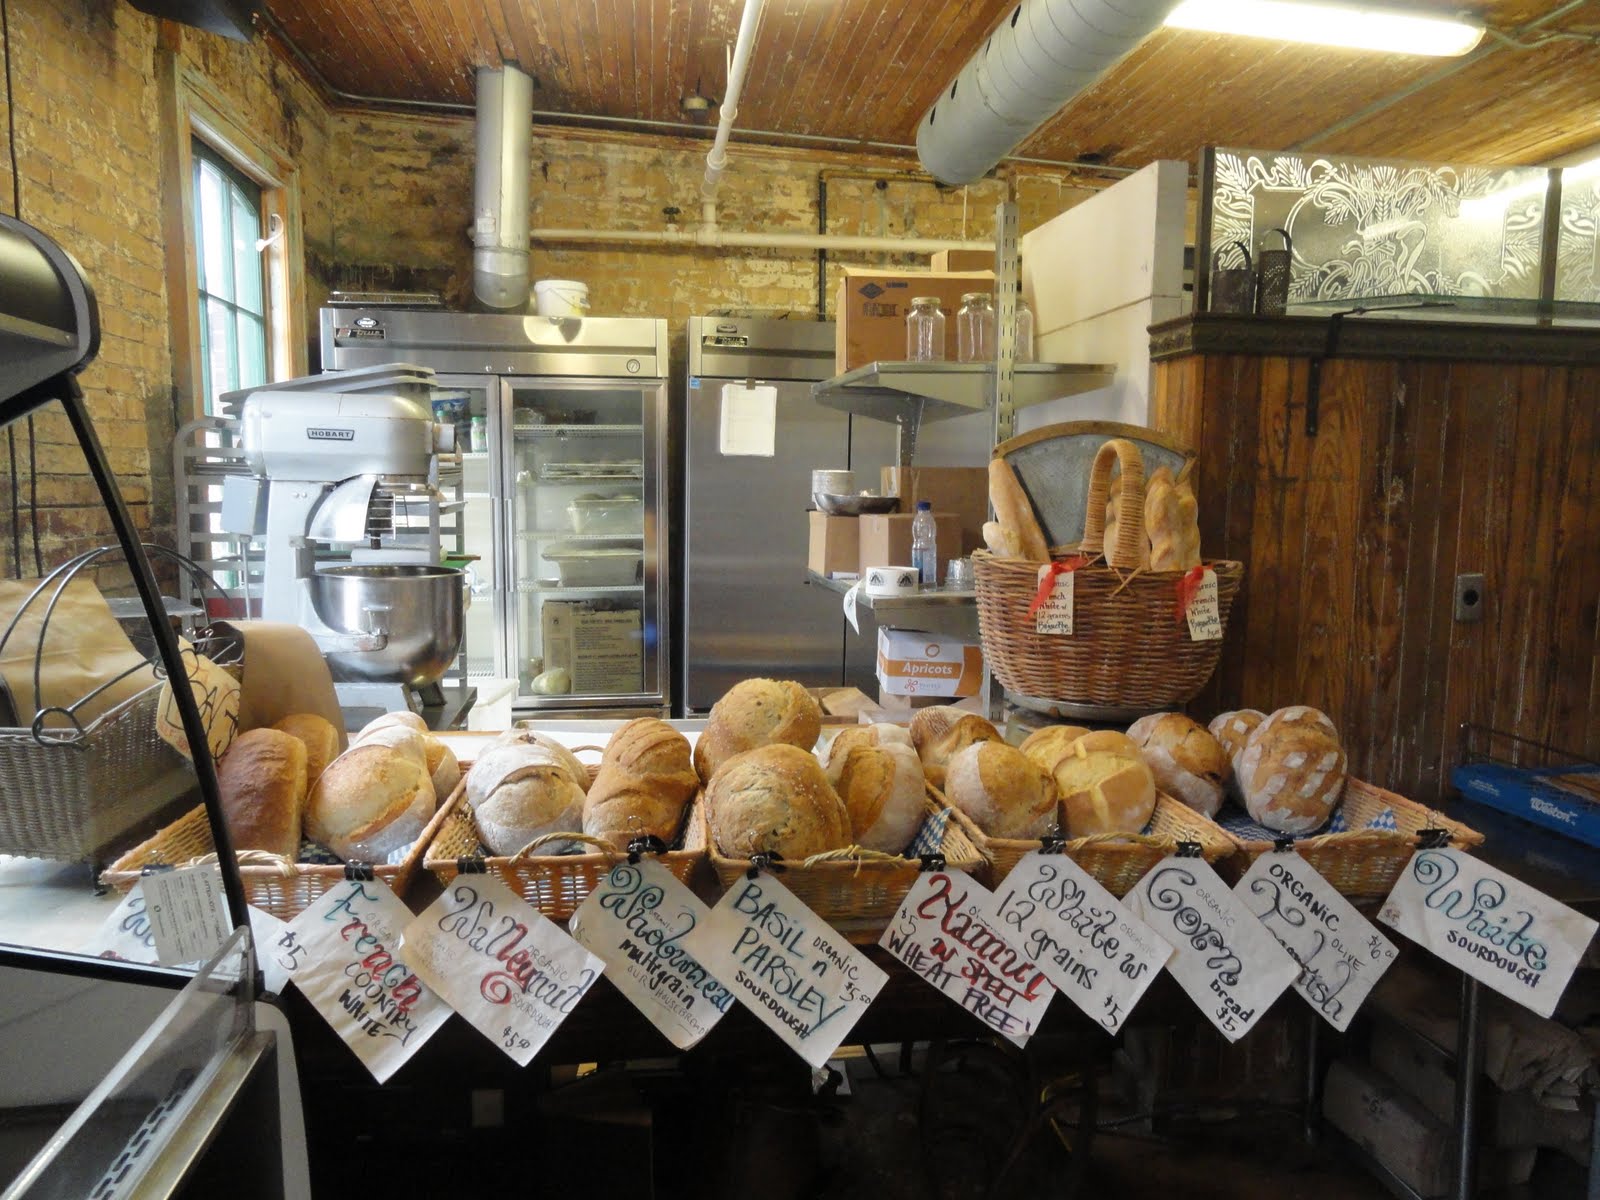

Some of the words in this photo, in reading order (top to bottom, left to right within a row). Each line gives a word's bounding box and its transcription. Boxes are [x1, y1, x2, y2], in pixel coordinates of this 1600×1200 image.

[311, 430, 351, 438] HOBART
[902, 661, 953, 676] Apricots
[734, 883, 804, 958] BASIL
[900, 907, 918, 936] $5
[1028, 864, 1120, 959] White
[1147, 868, 1242, 986] Corn
[1196, 888, 1235, 927] ORGANIC
[1269, 864, 1340, 932] ORGANIC
[1413, 852, 1548, 971] White
[278, 930, 307, 971] $5
[324, 883, 423, 1013] French
[813, 936, 859, 981] ORGANIC
[888, 930, 962, 990] WHEAT
[917, 874, 1057, 1001] Kamut
[996, 890, 1036, 932] 12
[1024, 928, 1098, 990] grains
[1331, 938, 1366, 972] OLIVE
[1447, 930, 1541, 988] SOURDOUGH
[732, 927, 846, 1037] PARSLEY
[812, 960, 828, 978] n
[961, 957, 1031, 1009] SPELT
[345, 962, 418, 1047] COUNTRY
[735, 970, 810, 1040] SOURDOUGH
[1100, 995, 1123, 1028] $5
[1209, 979, 1255, 1023] bread
[1215, 1006, 1239, 1032] $5
